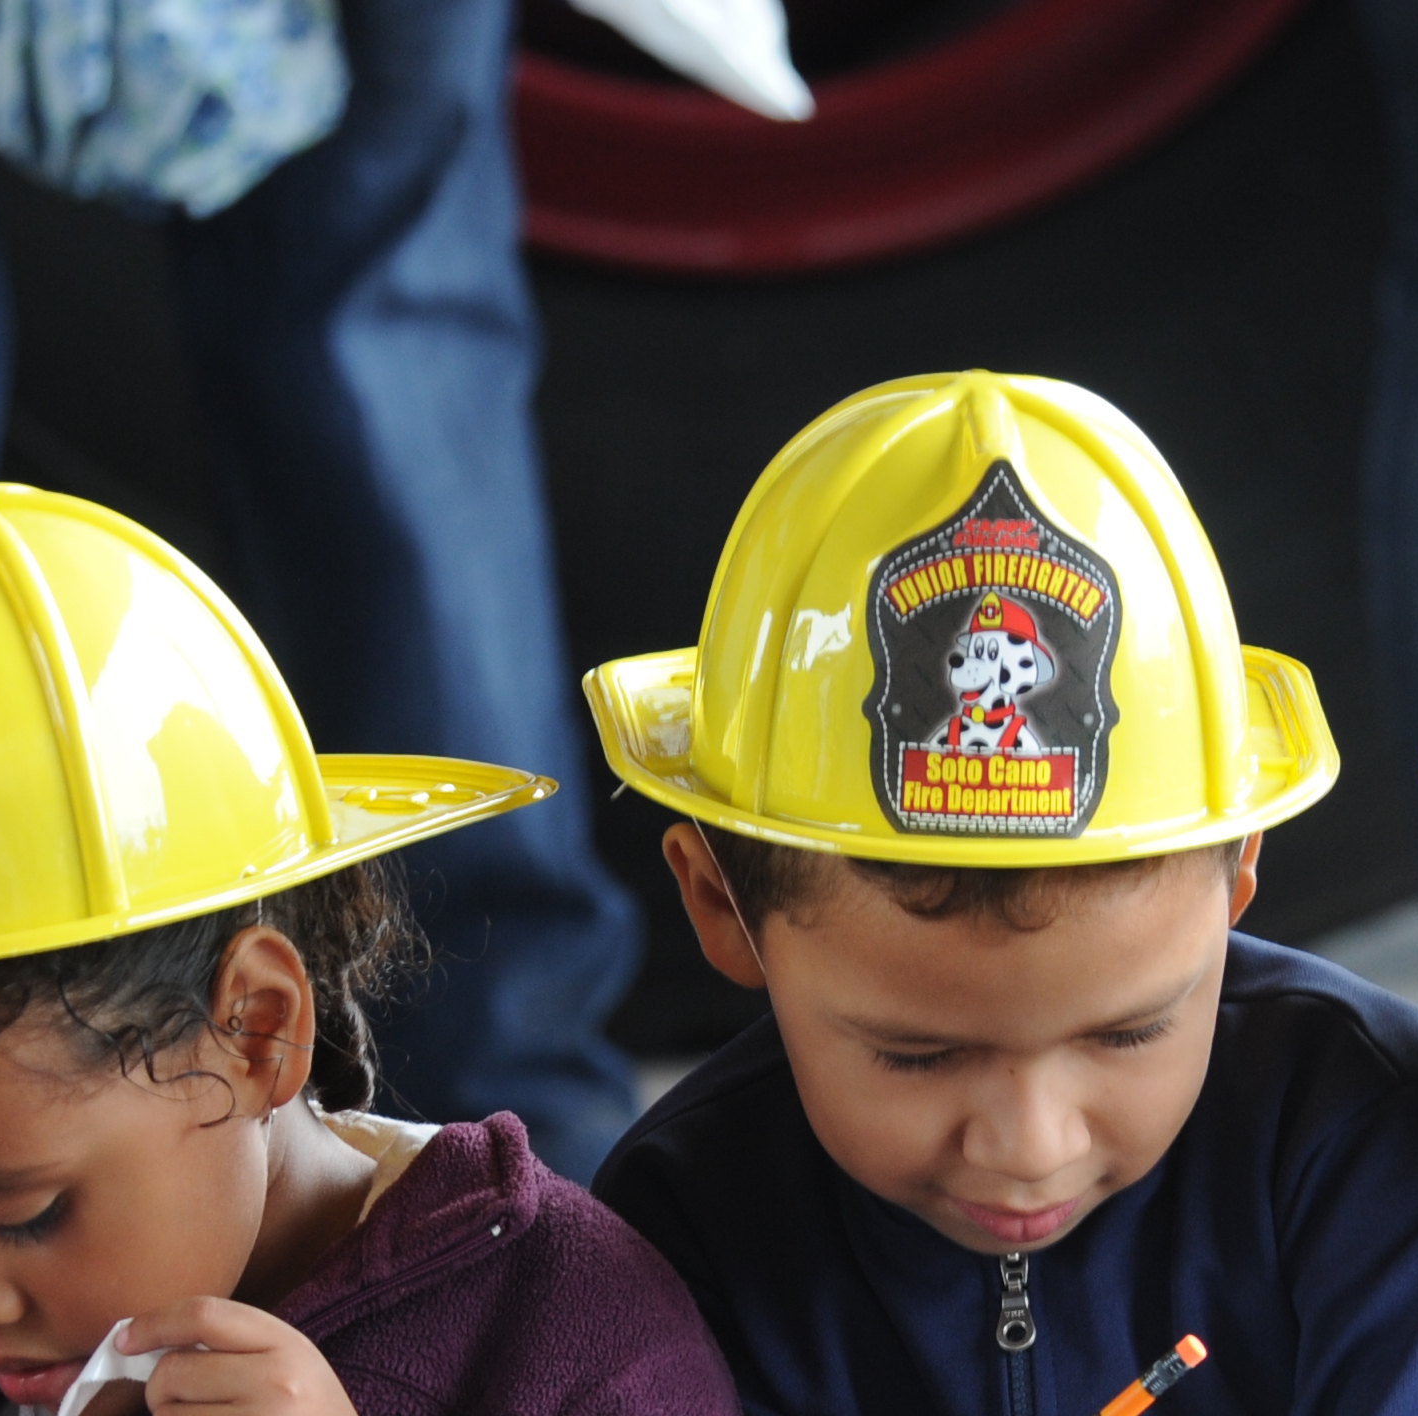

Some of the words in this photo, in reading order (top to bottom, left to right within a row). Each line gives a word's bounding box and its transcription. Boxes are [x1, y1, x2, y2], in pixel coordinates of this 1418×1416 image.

[891, 555, 968, 616] JUNIOR
[974, 553, 1103, 620] FIREFIGHTER
[926, 753, 983, 784] Soto
[988, 754, 1051, 787] Cano
[904, 780, 944, 812] Fire
[947, 783, 1072, 815] Department
